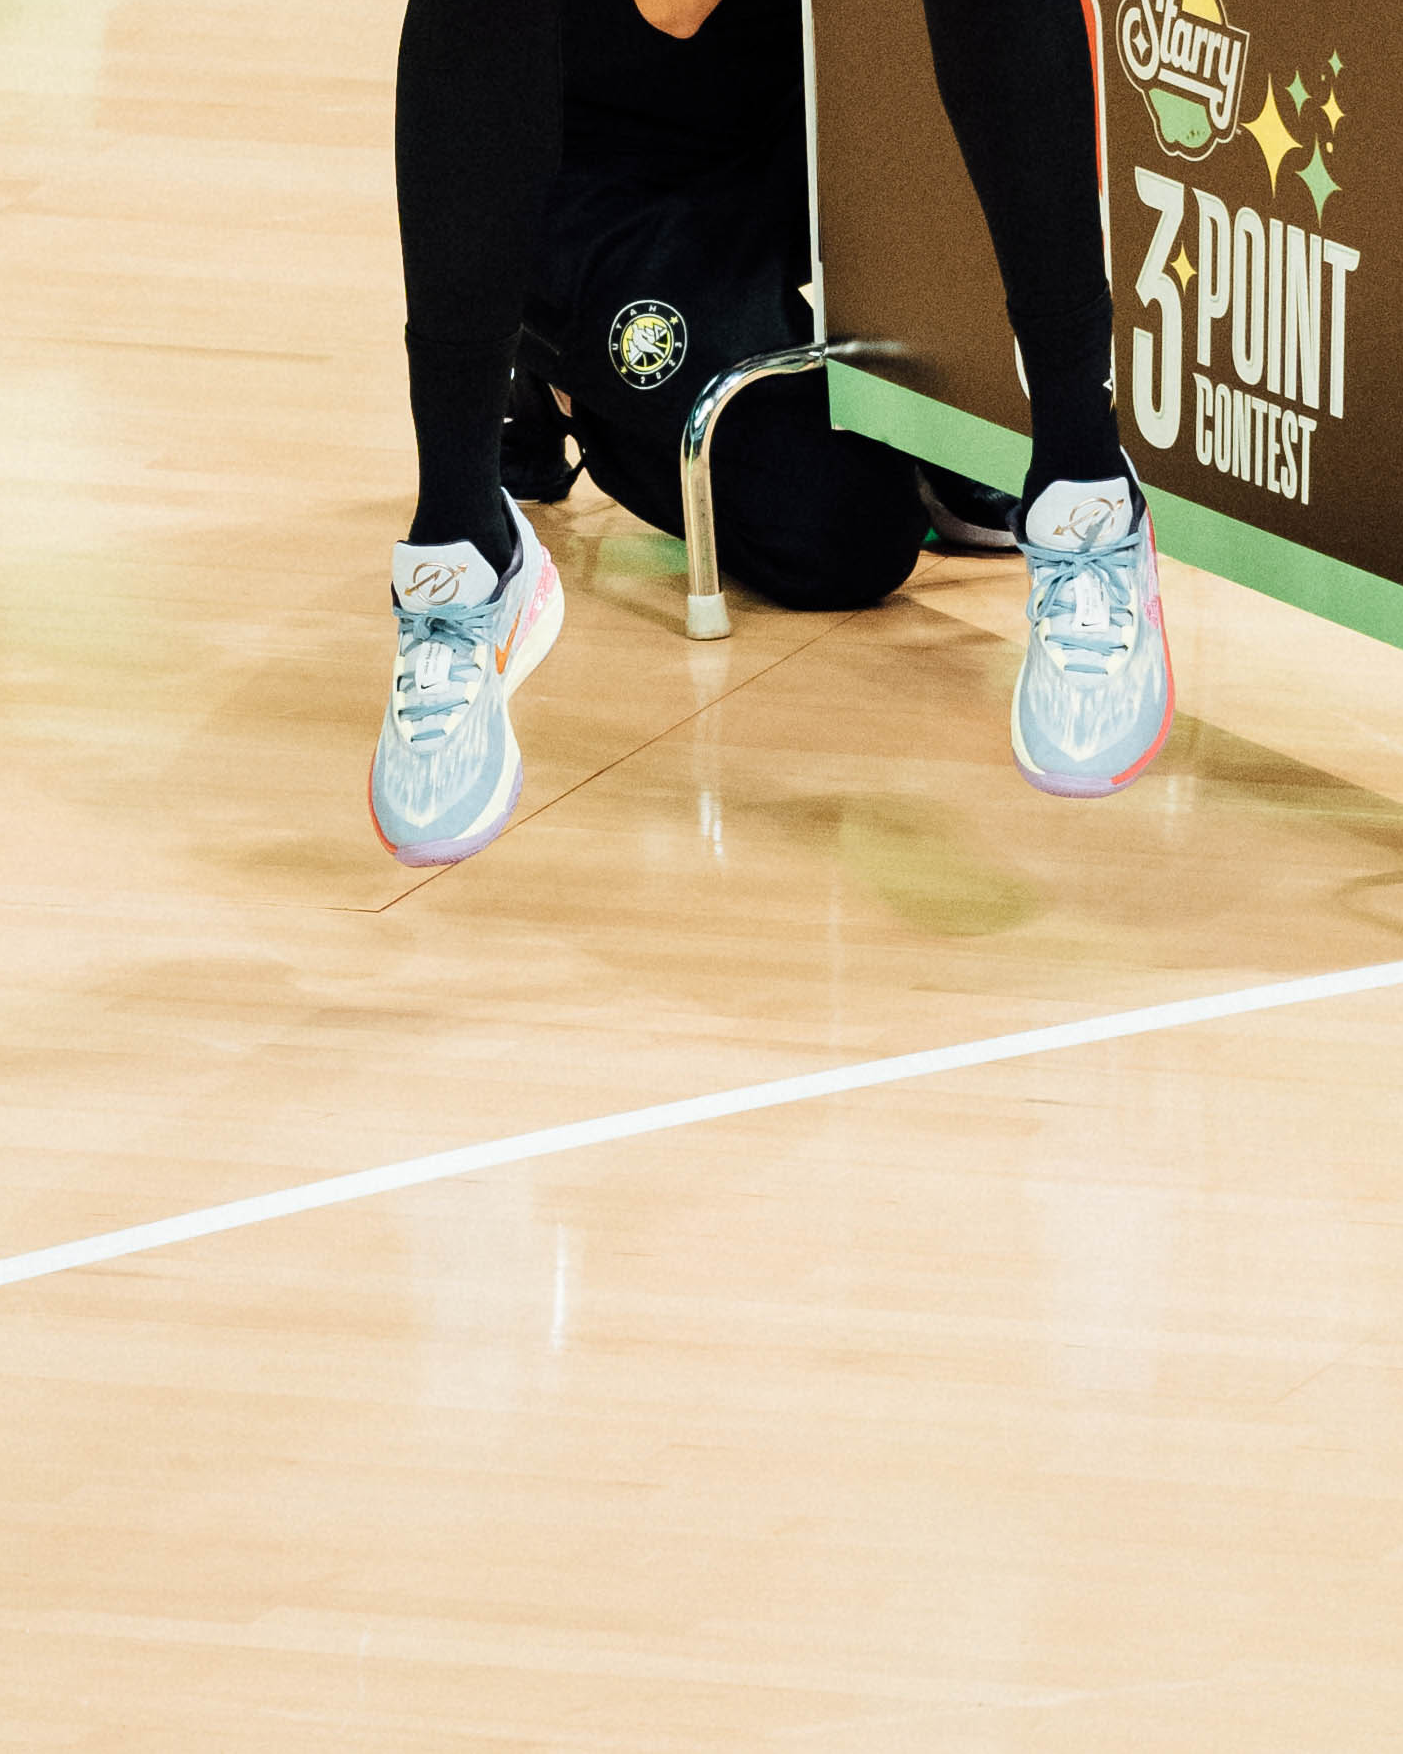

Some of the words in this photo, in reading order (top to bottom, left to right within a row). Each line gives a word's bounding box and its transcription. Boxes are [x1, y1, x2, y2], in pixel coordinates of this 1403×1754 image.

[611, 304, 657, 351] UTAH
[1132, 165, 1185, 450] 3
[1192, 187, 1361, 420] POINT
[1192, 372, 1318, 505] CONTEST
